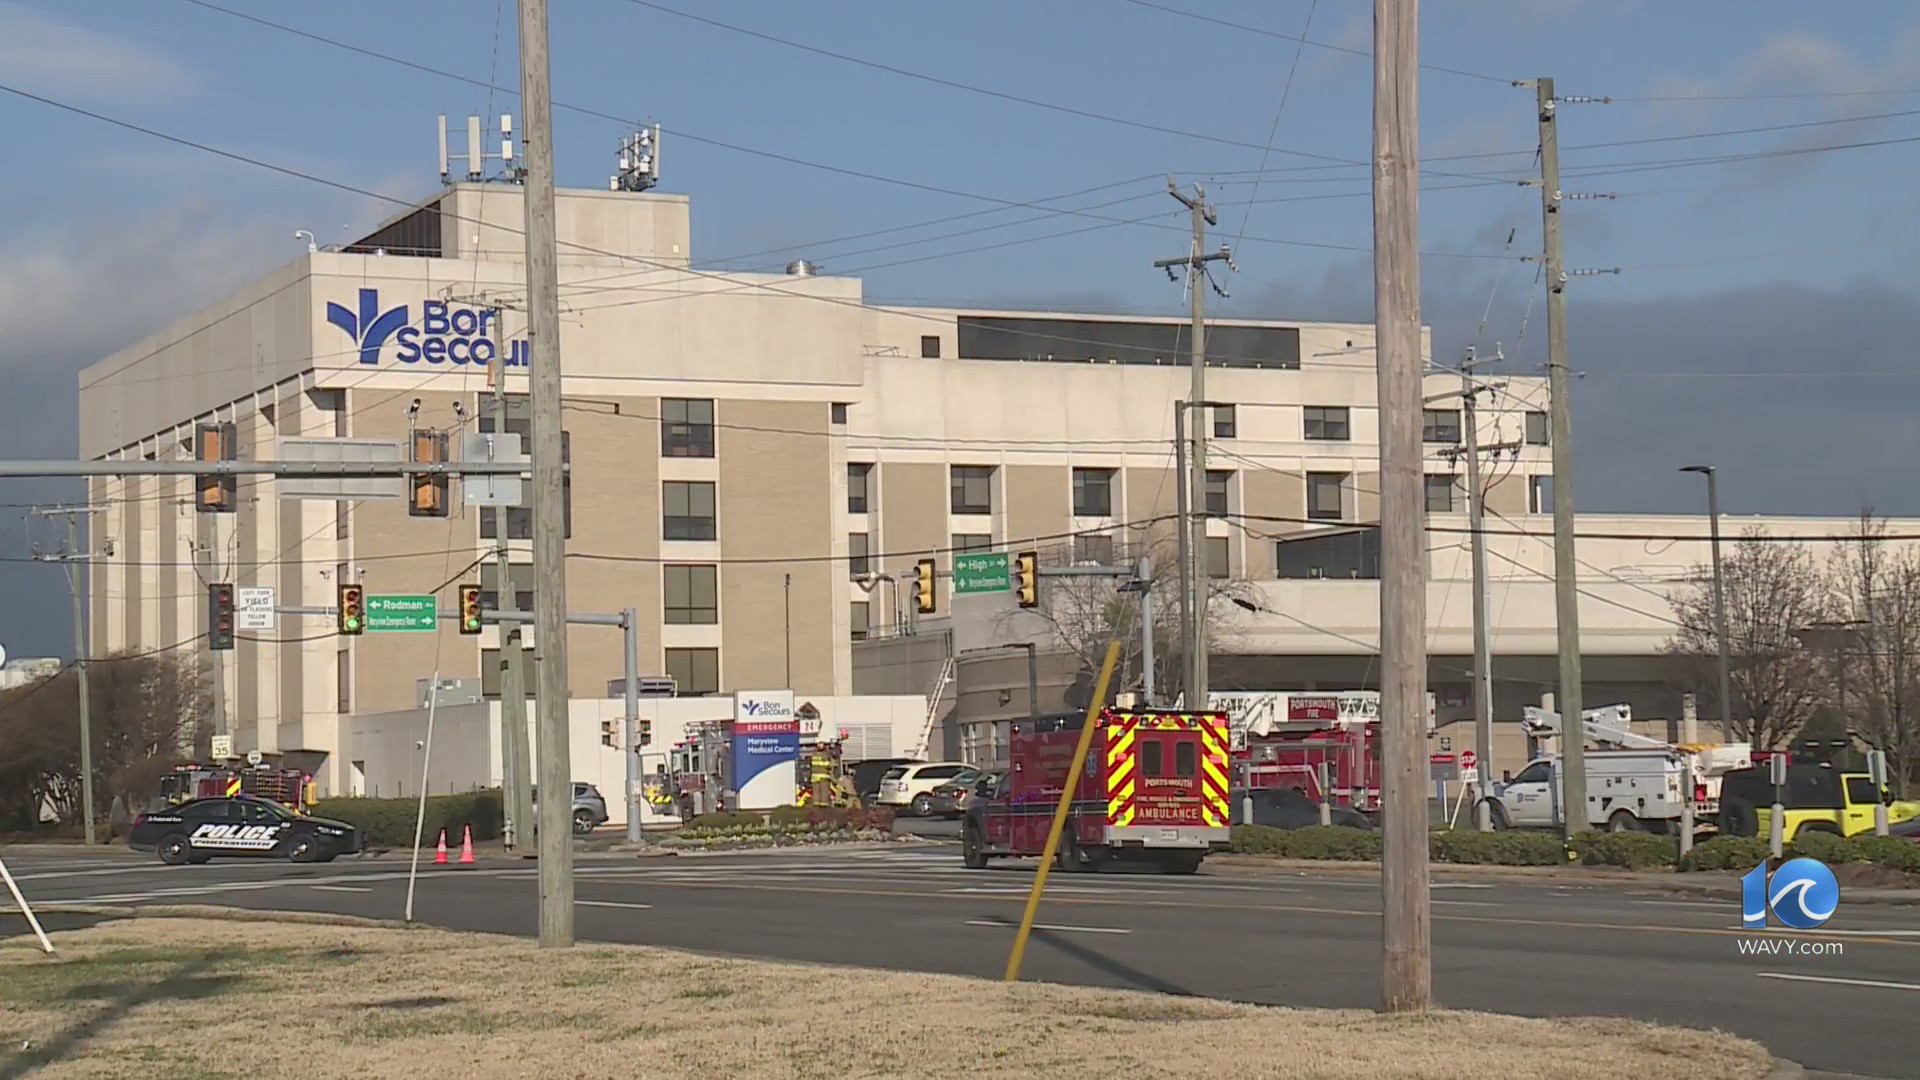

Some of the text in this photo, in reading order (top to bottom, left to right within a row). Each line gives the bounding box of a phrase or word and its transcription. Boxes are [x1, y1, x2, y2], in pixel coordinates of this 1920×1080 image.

[968, 559, 988, 573] High
[245, 597, 269, 605] YIELD
[383, 599, 423, 610] Rodman
[763, 700, 780, 710] Bon
[1290, 699, 1336, 711] PORTSMOUTH
[758, 707, 791, 716] Secours
[1306, 708, 1320, 719] FIRE
[747, 722, 792, 732] EMERGENCY
[747, 737, 779, 747] Maryview
[215, 746, 229, 756] 35
[747, 745, 795, 755] Medical Center
[1460, 754, 1476, 765] STOP
[1144, 778, 1193, 789] PORTSMOUTH
[1139, 807, 1198, 820] AMBULANCE
[191, 823, 280, 840] POLICE
